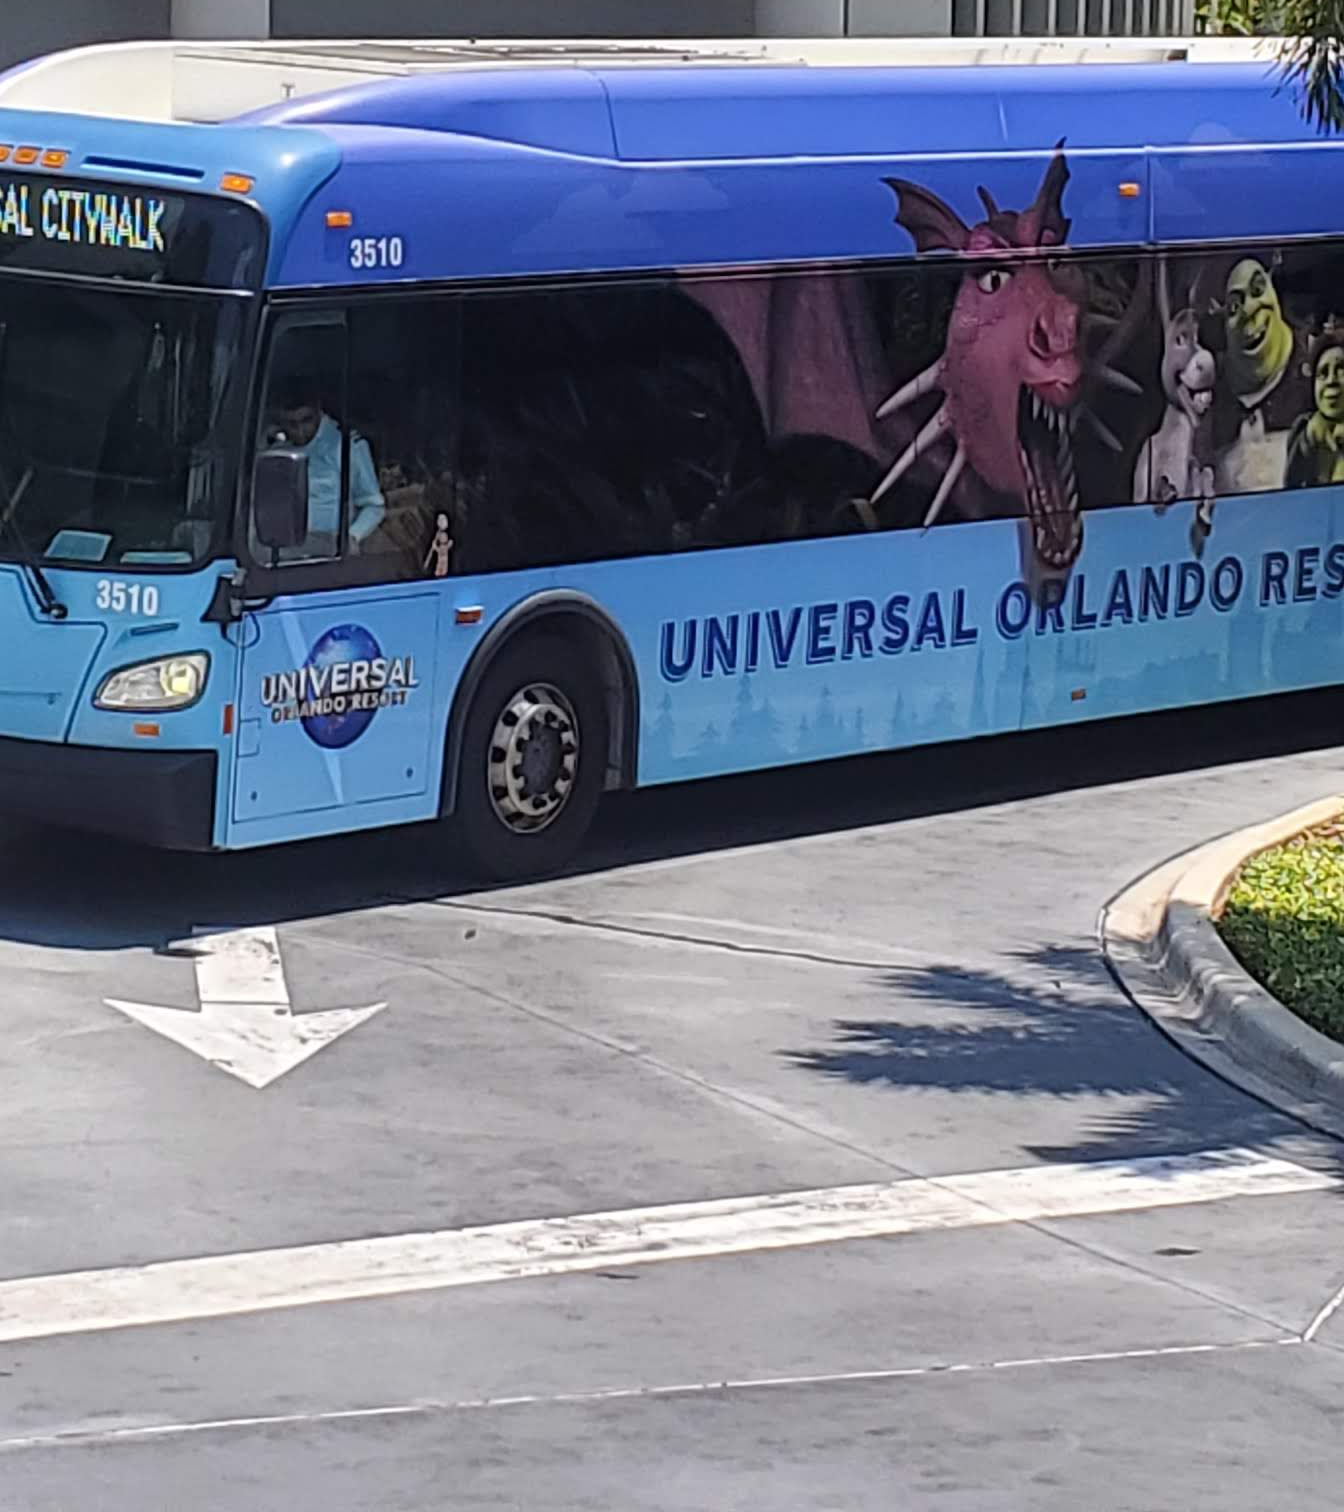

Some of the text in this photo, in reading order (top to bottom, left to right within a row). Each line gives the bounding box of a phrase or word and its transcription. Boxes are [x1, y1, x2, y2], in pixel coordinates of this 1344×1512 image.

[41, 188, 166, 252] CITYWALK
[349, 236, 403, 268] 3510
[96, 579, 159, 616] 3510
[659, 588, 979, 684] UNIVERSAL
[996, 556, 1244, 639] ORLANDO
[260, 656, 420, 706] UNIVERSAL
[271, 695, 346, 724] ORLANDO
